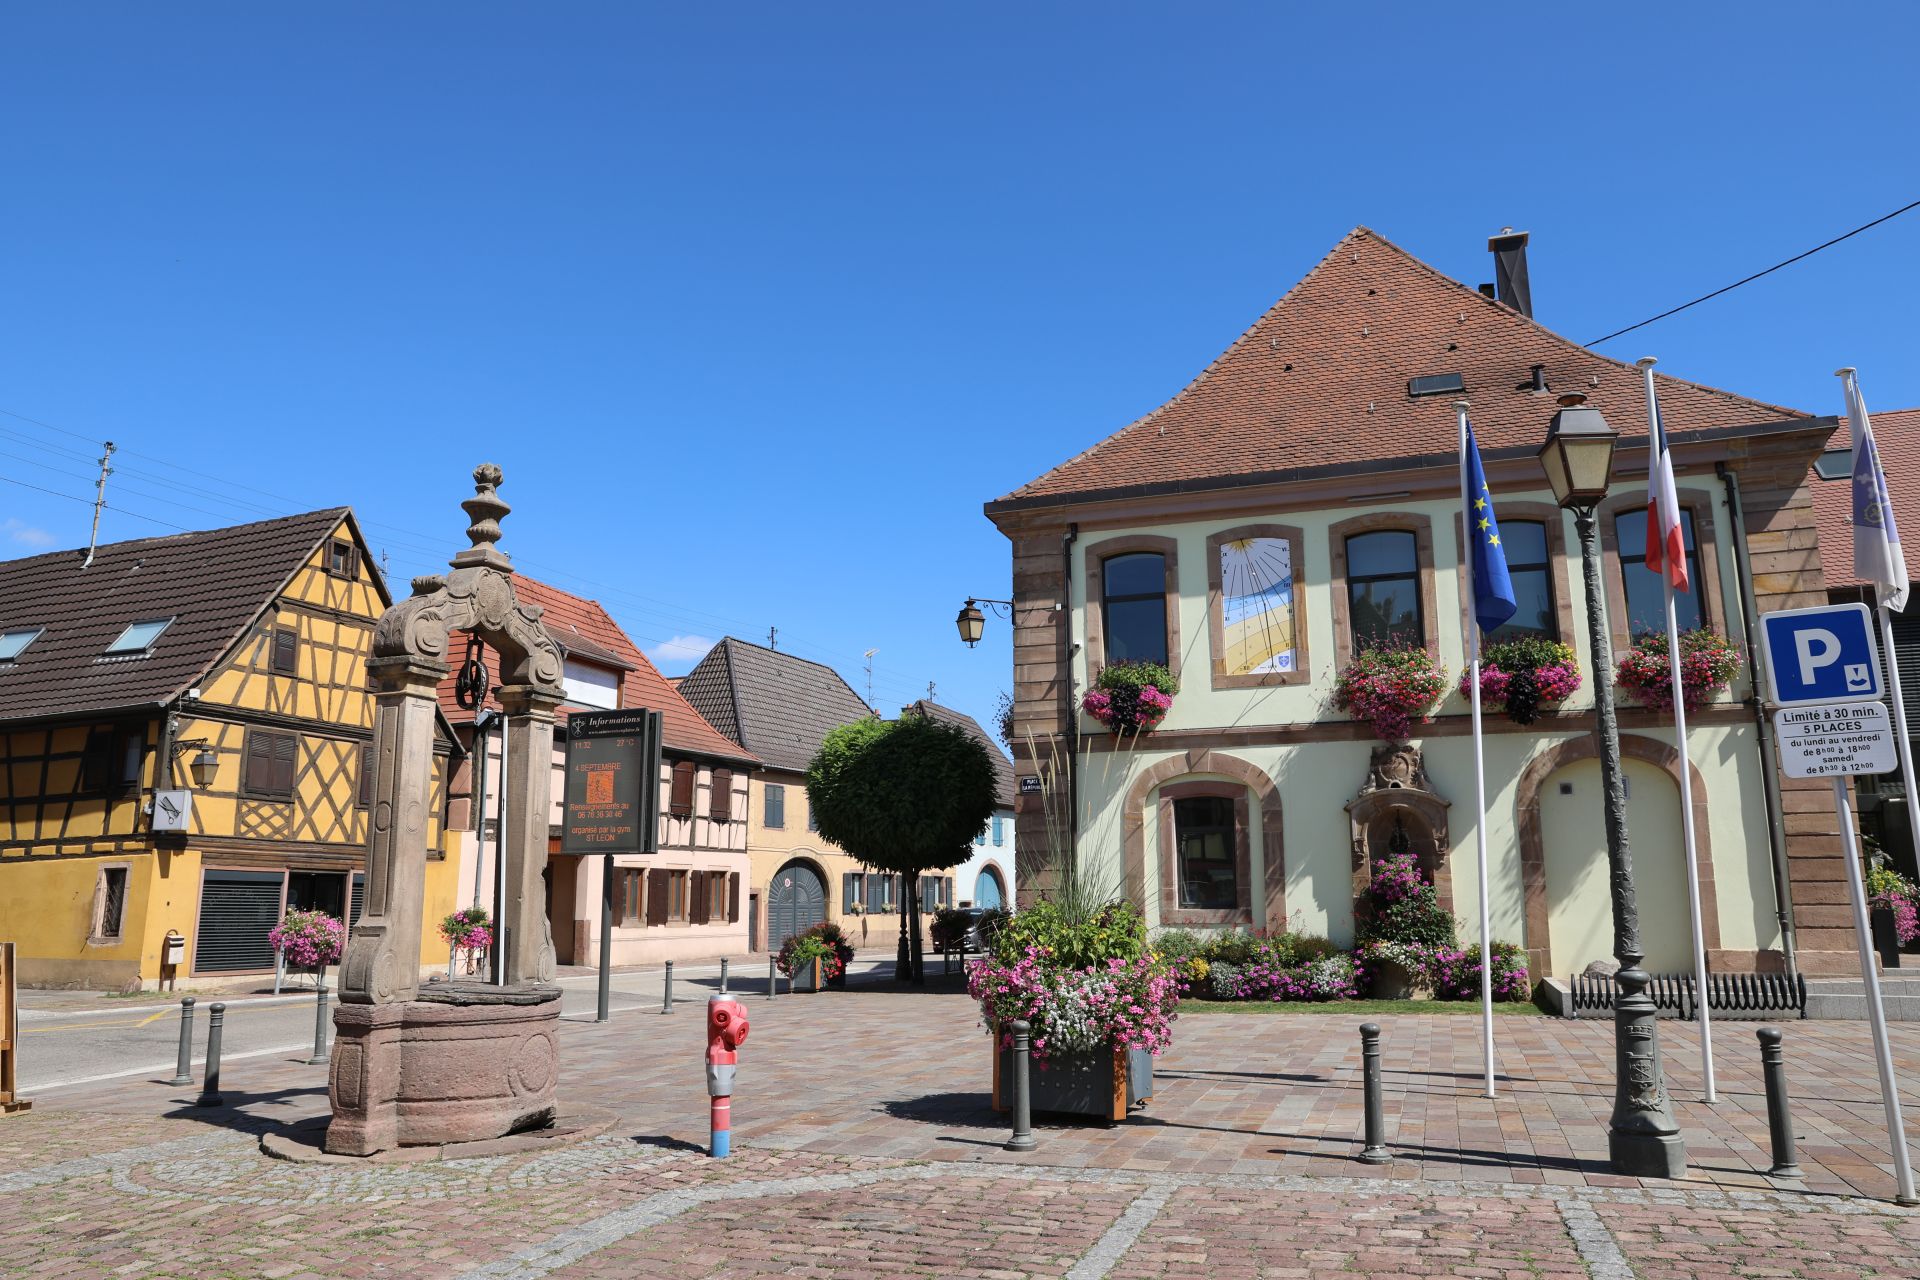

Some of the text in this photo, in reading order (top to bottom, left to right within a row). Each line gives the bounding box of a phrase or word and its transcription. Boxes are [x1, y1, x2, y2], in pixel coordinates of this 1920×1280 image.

[1793, 628, 1842, 686] P
[1783, 706, 1879, 722] Limité à 30 min.
[589, 715, 641, 728] Informations
[1803, 721, 1862, 734] 5 PLACES
[1804, 737, 1826, 746] lundi
[1841, 734, 1881, 743] vendredi
[1815, 746, 1835, 755] 8h00
[1847, 744, 1871, 753] 18h00
[1822, 754, 1854, 763] samedi
[580, 762, 622, 772] SEPTEMBRE
[1806, 762, 1874, 774] de 8h30 à 12h00
[598, 826, 609, 835] par
[616, 826, 631, 835] gym
[585, 833, 595, 842] ST
